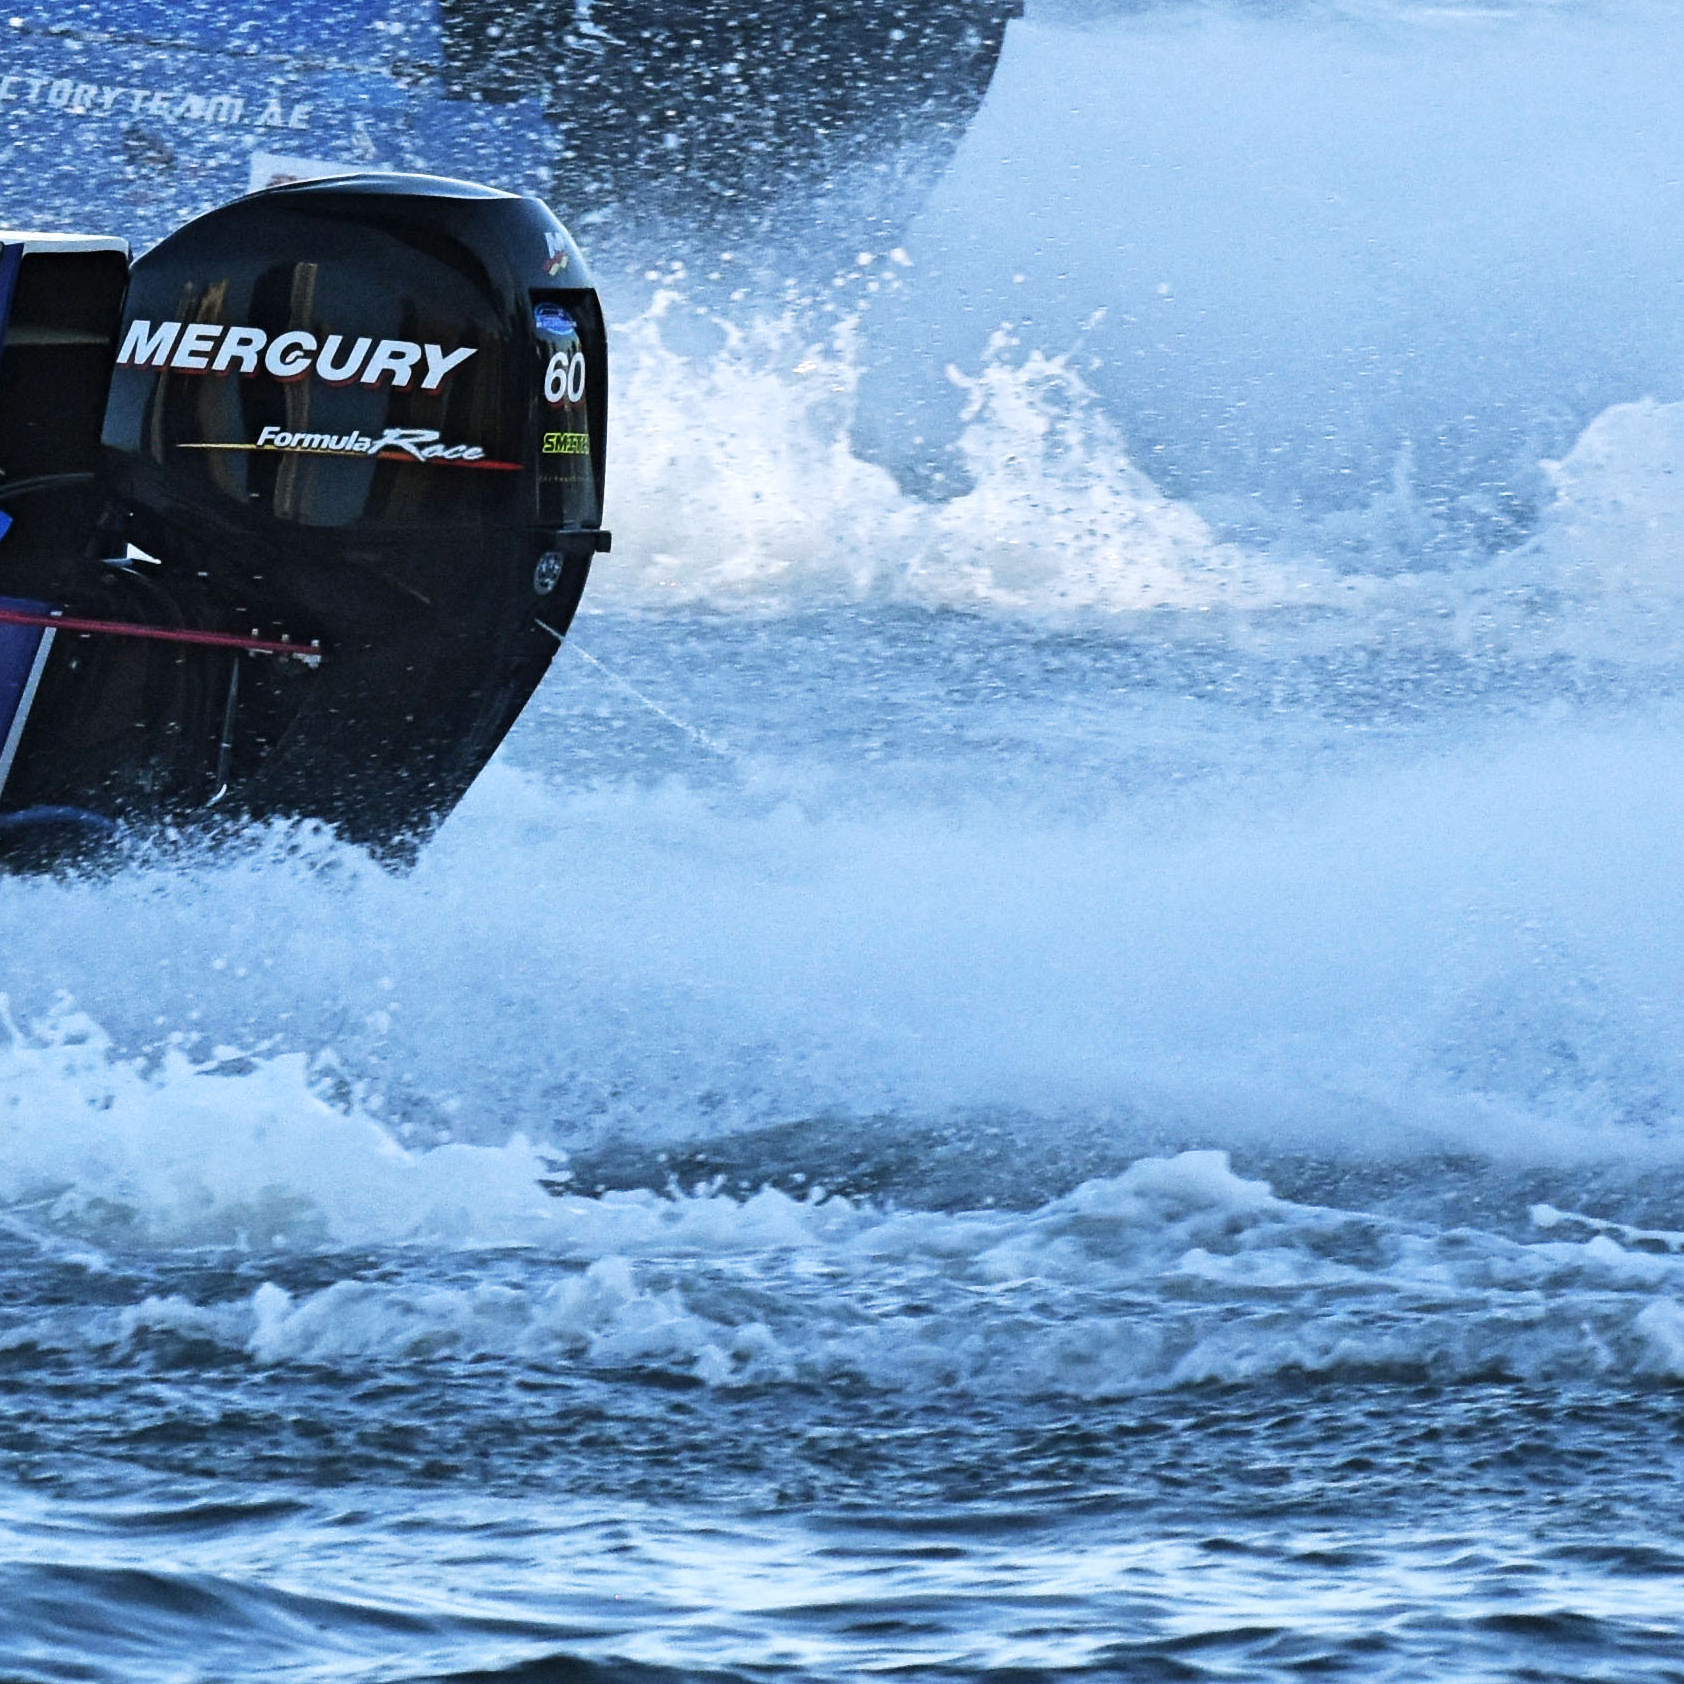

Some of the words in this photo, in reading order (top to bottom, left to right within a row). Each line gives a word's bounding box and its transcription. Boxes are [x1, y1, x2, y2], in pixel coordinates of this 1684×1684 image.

[115, 319, 479, 392] MERCURY
[544, 351, 586, 403] 60
[255, 424, 377, 454] Formula
[367, 426, 486, 463] Race
